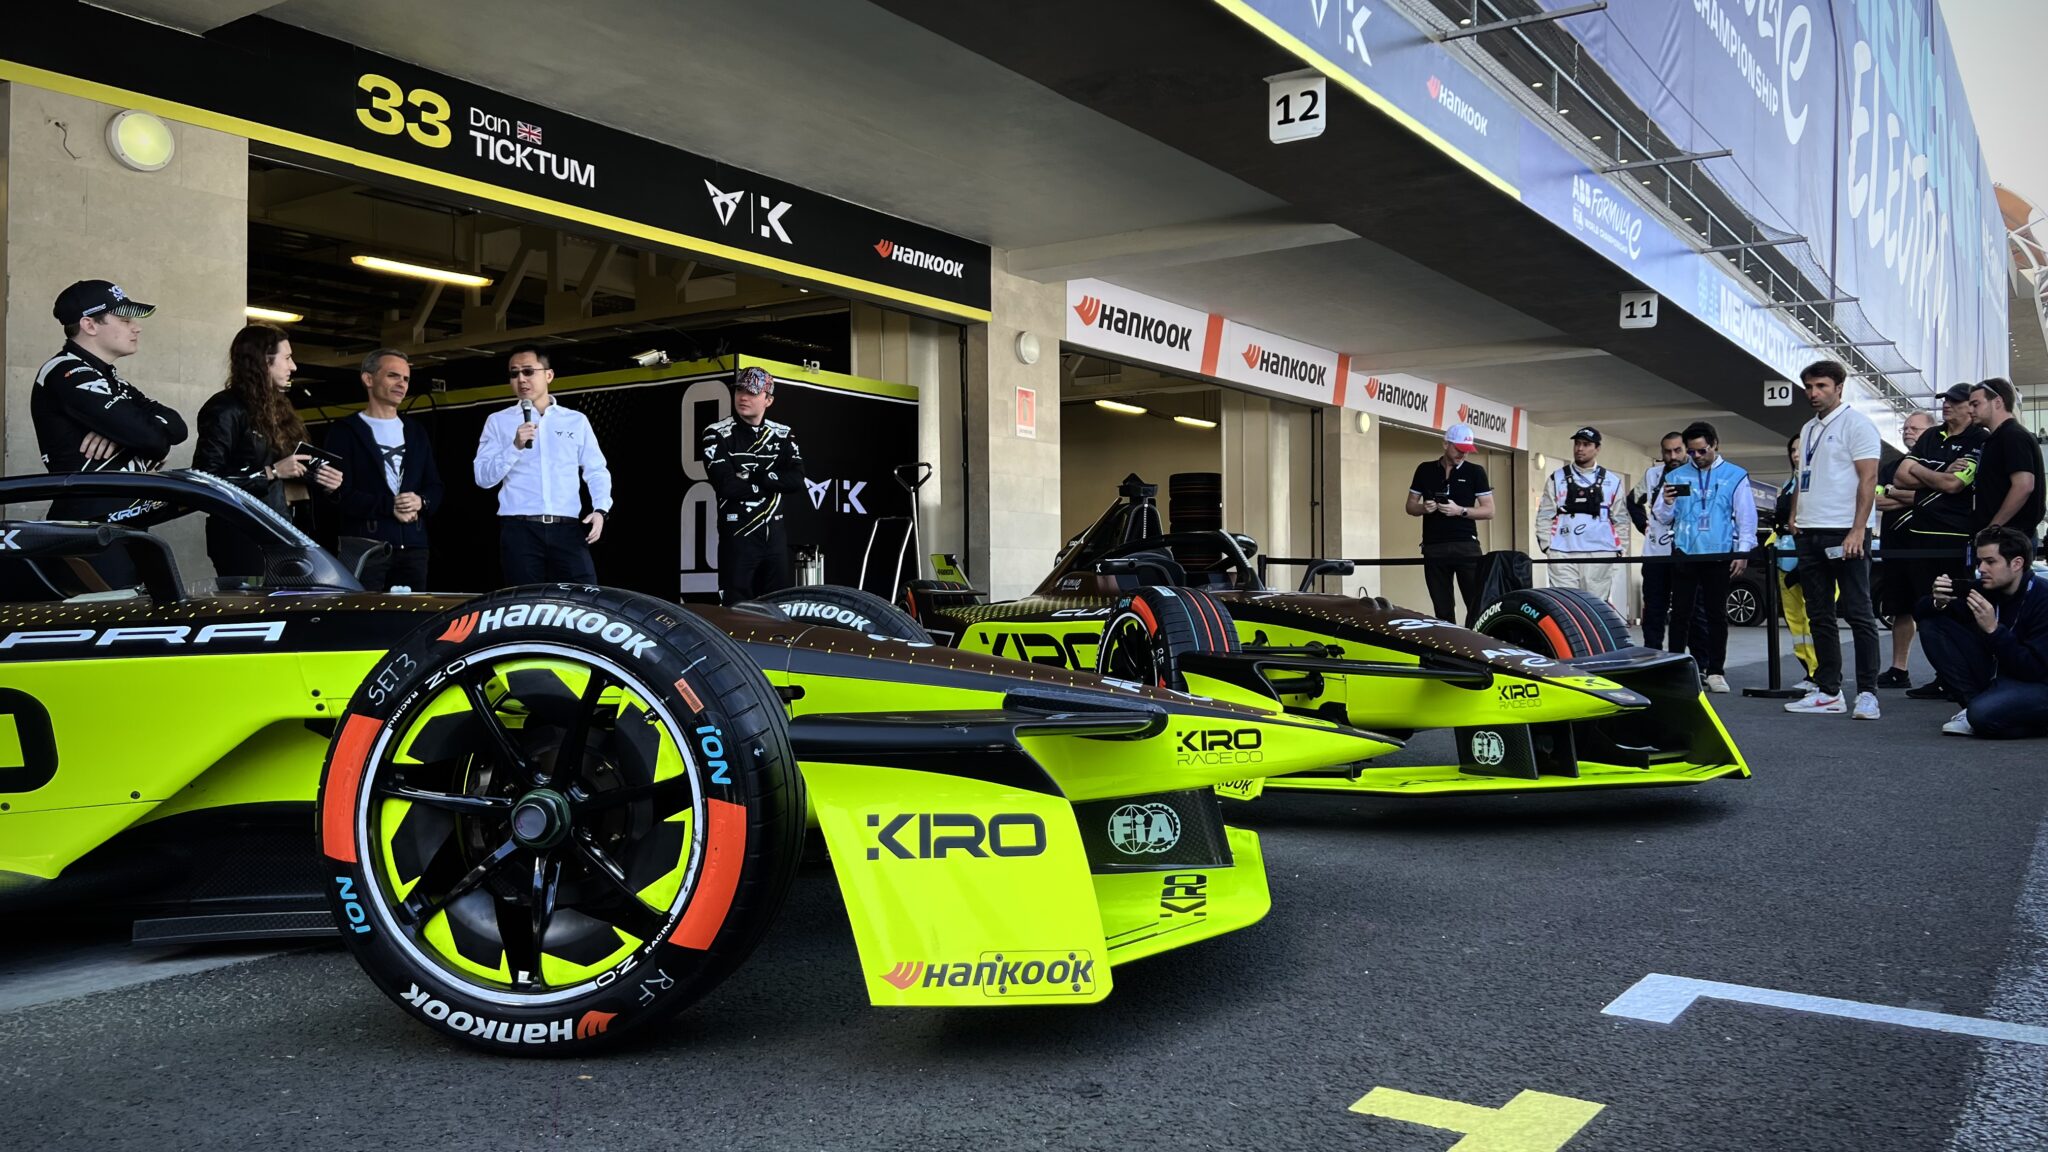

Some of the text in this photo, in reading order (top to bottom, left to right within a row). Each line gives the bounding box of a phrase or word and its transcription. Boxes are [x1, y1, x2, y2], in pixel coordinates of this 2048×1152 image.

[356, 73, 452, 149] 33
[469, 106, 511, 136] Dan
[1275, 89, 1320, 126] 12
[469, 130, 596, 188] TICKTUM
[1624, 300, 1654, 319] 11
[1721, 284, 1766, 358] MEXICO
[1766, 386, 1790, 400] 10
[1497, 683, 1540, 700] KIRO
[1176, 728, 1262, 752] KIRO
[867, 812, 1047, 861] KIRO
[1159, 873, 1208, 918] KIRO
